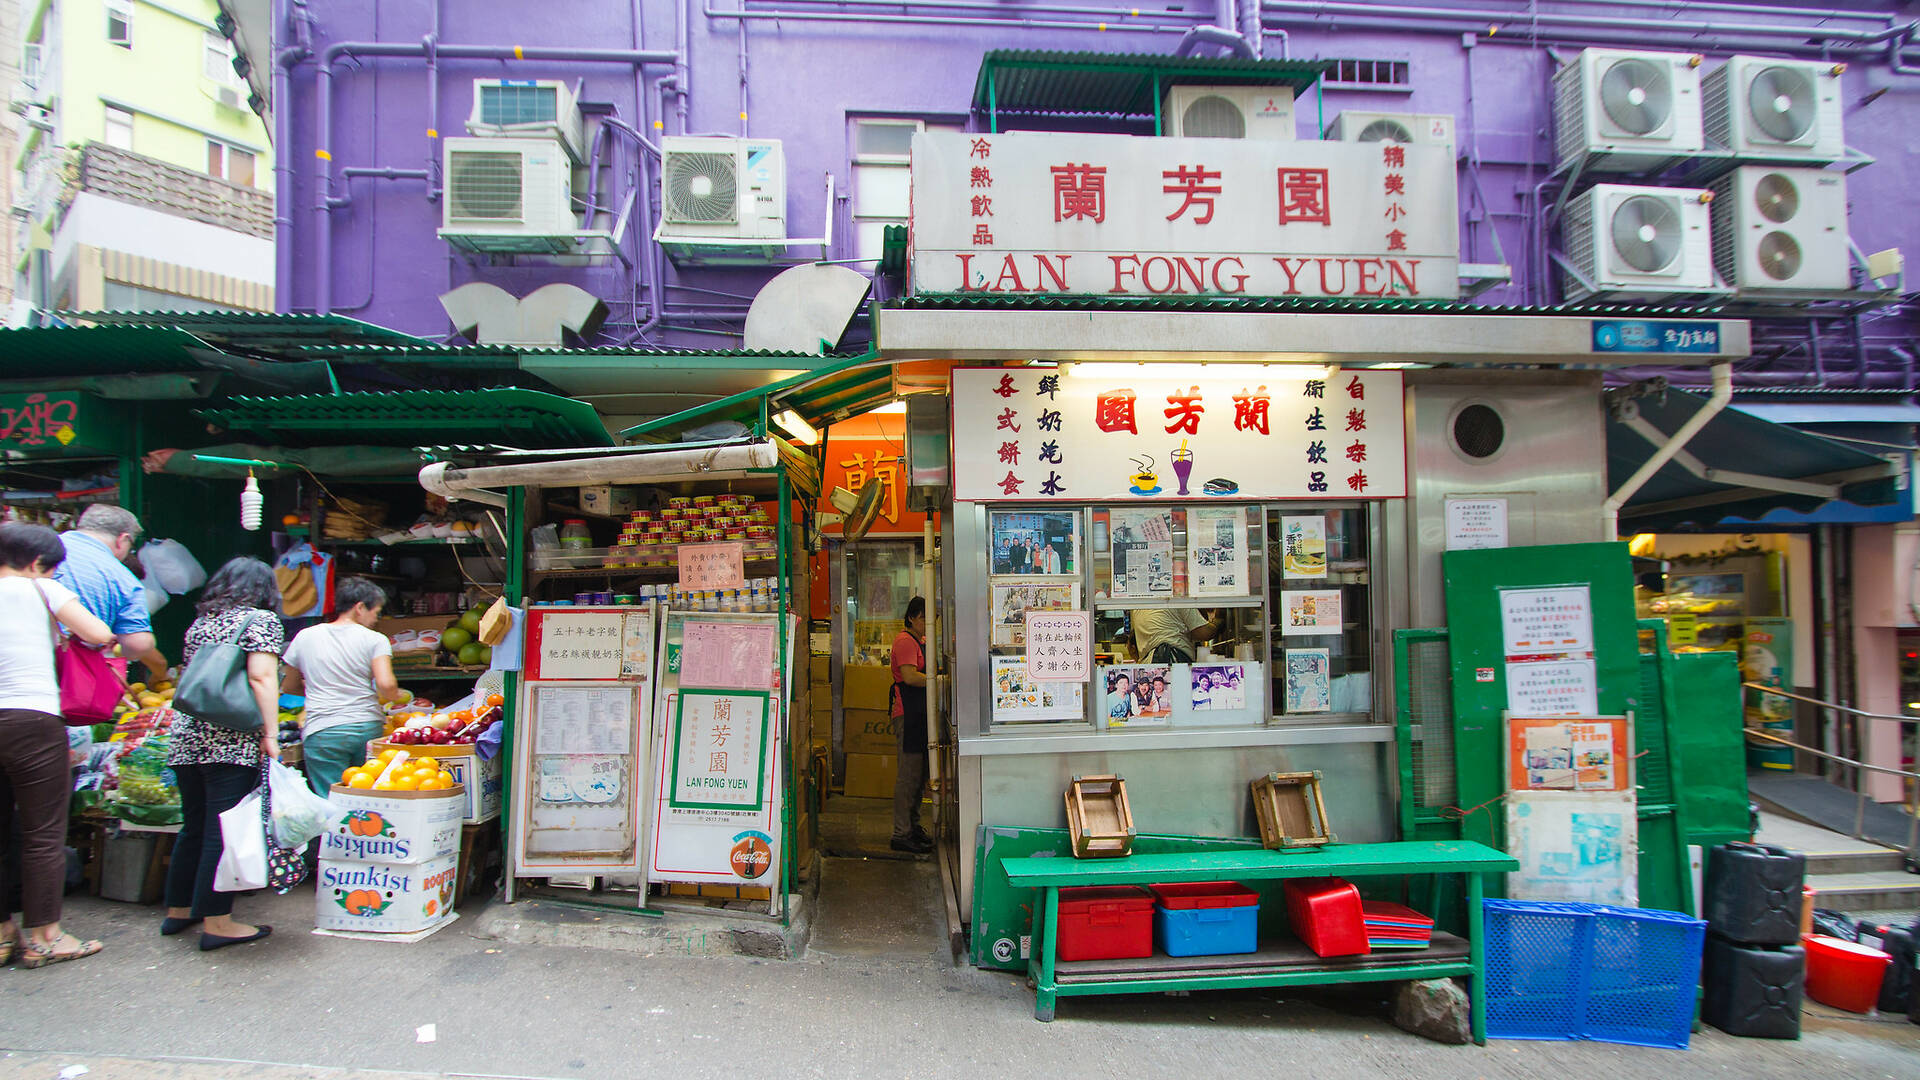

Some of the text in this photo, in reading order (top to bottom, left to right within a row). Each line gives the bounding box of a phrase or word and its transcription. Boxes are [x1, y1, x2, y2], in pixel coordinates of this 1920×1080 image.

[970, 137, 994, 245] 冷熱飲品
[1050, 162, 1331, 227] 蘭芳園
[1383, 145, 1407, 251] 精美小食
[956, 252, 1422, 298] LAN FONG YUEN
[992, 373, 1024, 496] 各式餅食
[1303, 380, 1328, 492] 衛生飲品
[553, 626, 618, 637] 五十年老字號
[1035, 660, 1083, 672] 多謝合作
[709, 698, 733, 774] 蘭芳園
[686, 777, 748, 789] LAN FONG YUEN
[322, 865, 412, 893] Sunkist
